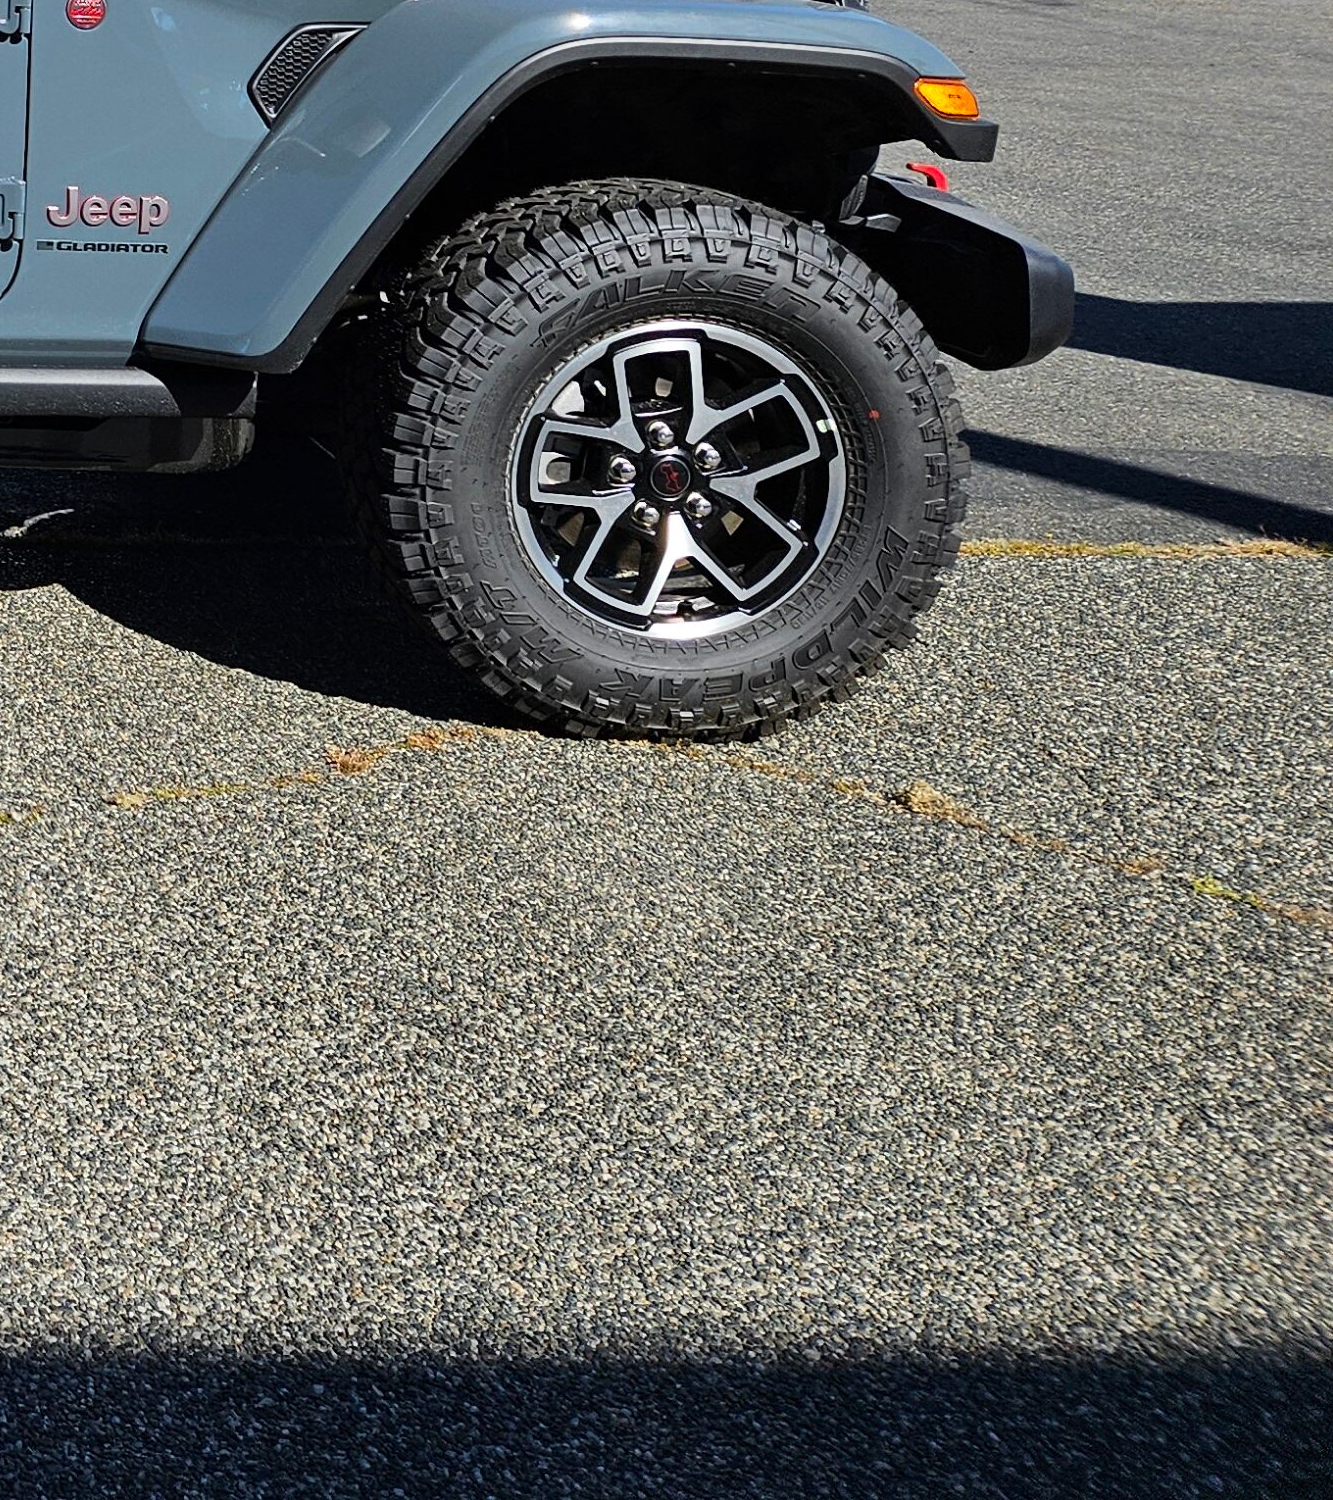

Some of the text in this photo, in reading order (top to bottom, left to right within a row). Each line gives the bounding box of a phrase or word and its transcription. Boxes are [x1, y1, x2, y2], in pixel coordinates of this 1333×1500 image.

[46, 185, 169, 235] Jeep
[55, 240, 169, 254] GLADIATOR
[531, 269, 821, 350] FALKEN
[479, 579, 584, 664] M/T
[598, 524, 910, 703] WILDPEAK
